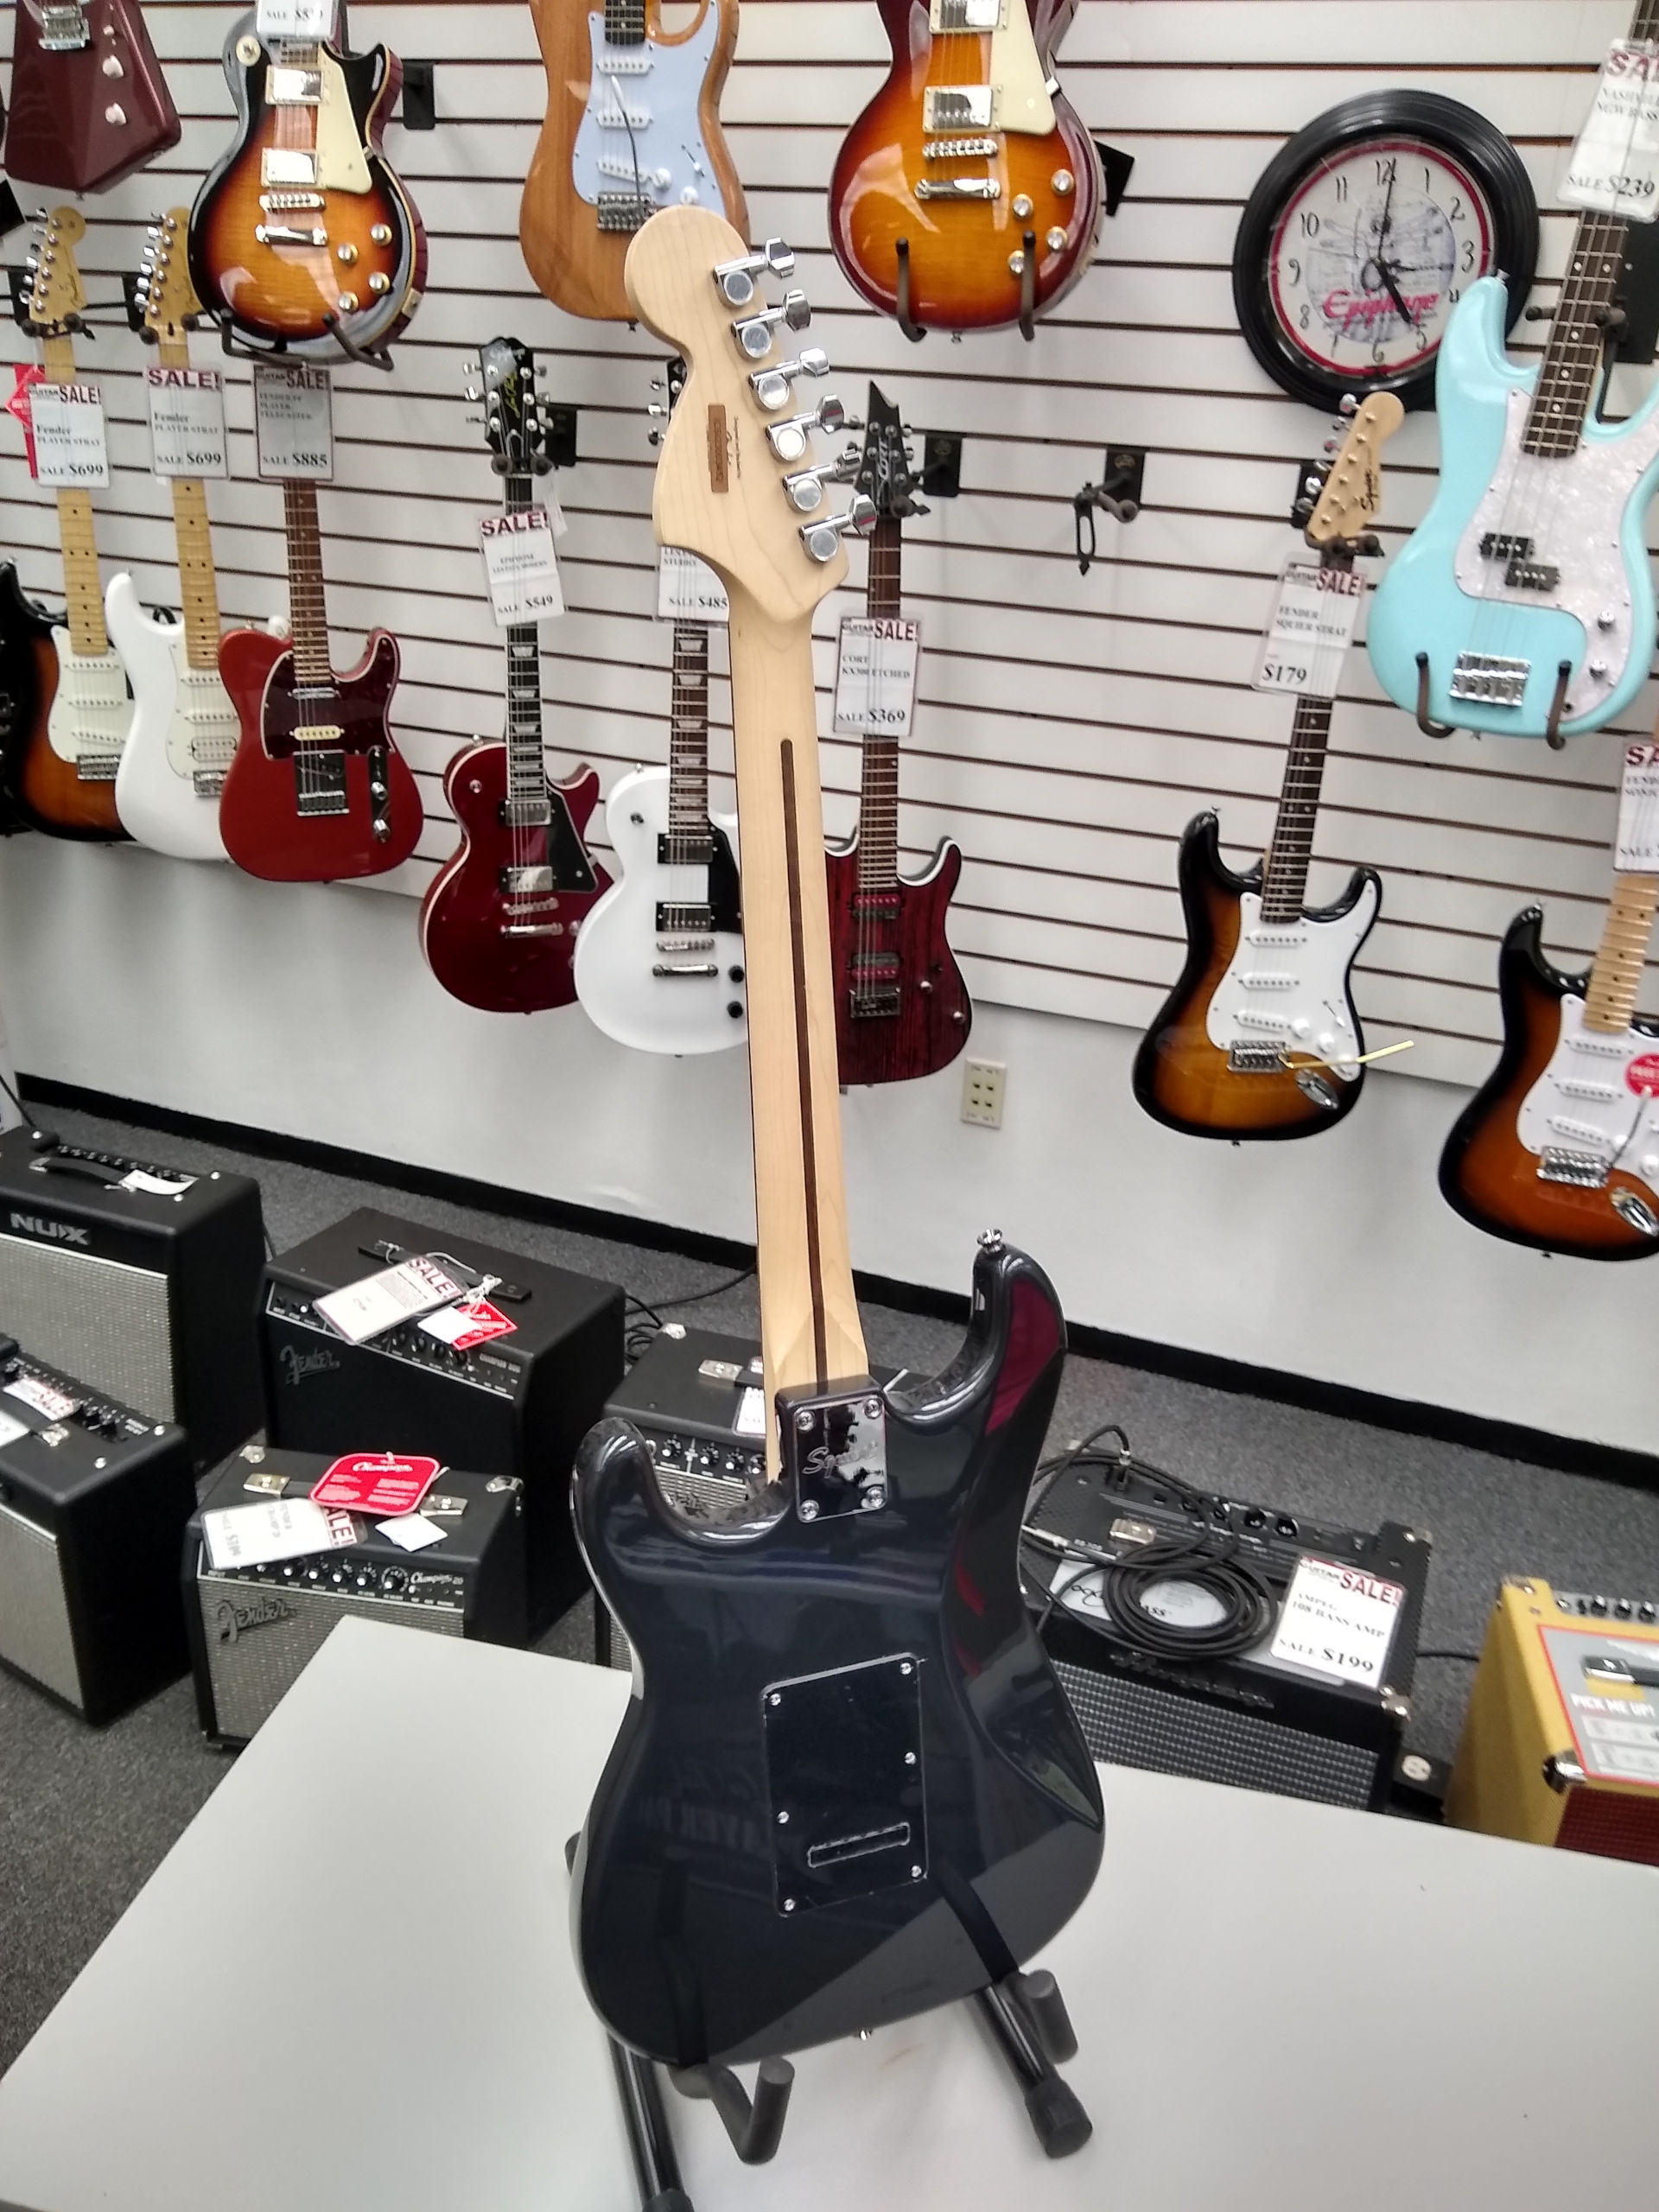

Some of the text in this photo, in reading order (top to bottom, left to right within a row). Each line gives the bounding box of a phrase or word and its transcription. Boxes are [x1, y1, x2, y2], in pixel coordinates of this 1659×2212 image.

[1335, 175, 1348, 203] 11
[1424, 167, 1431, 194] 1
[1567, 174, 1656, 198] SALE $239
[1450, 196, 1465, 222] 2
[1300, 212, 1320, 238] 10
[1461, 239, 1475, 274] 3
[1287, 258, 1301, 288] 9
[1299, 303, 1310, 330] 8
[1371, 337, 1385, 363] 6
[148, 368, 220, 389] SALE!
[60, 385, 102, 404] SALE!
[36, 424, 71, 434] Fender
[154, 411, 189, 423] Fender
[68, 462, 104, 478] $699
[156, 452, 222, 466] SALE $699
[262, 452, 328, 467] SALE $885
[481, 511, 549, 537] SALE!
[497, 594, 554, 614] SALE $549
[669, 594, 728, 609] SALE $485
[1279, 605, 1319, 620] FENDER
[1262, 663, 1308, 685] $179
[837, 708, 906, 724] SALE $369
[10, 1211, 91, 1246] NUX
[408, 1257, 461, 1299] SALE!
[279, 1344, 342, 1385] Fender
[323, 1508, 359, 1547] ALE!
[1339, 1570, 1403, 1606] SALE!
[215, 1596, 297, 1646] Fender
[1315, 1608, 1350, 1626] BASS
[1355, 1623, 1385, 1638] AMP
[1279, 1638, 1374, 1673] SALE $199
